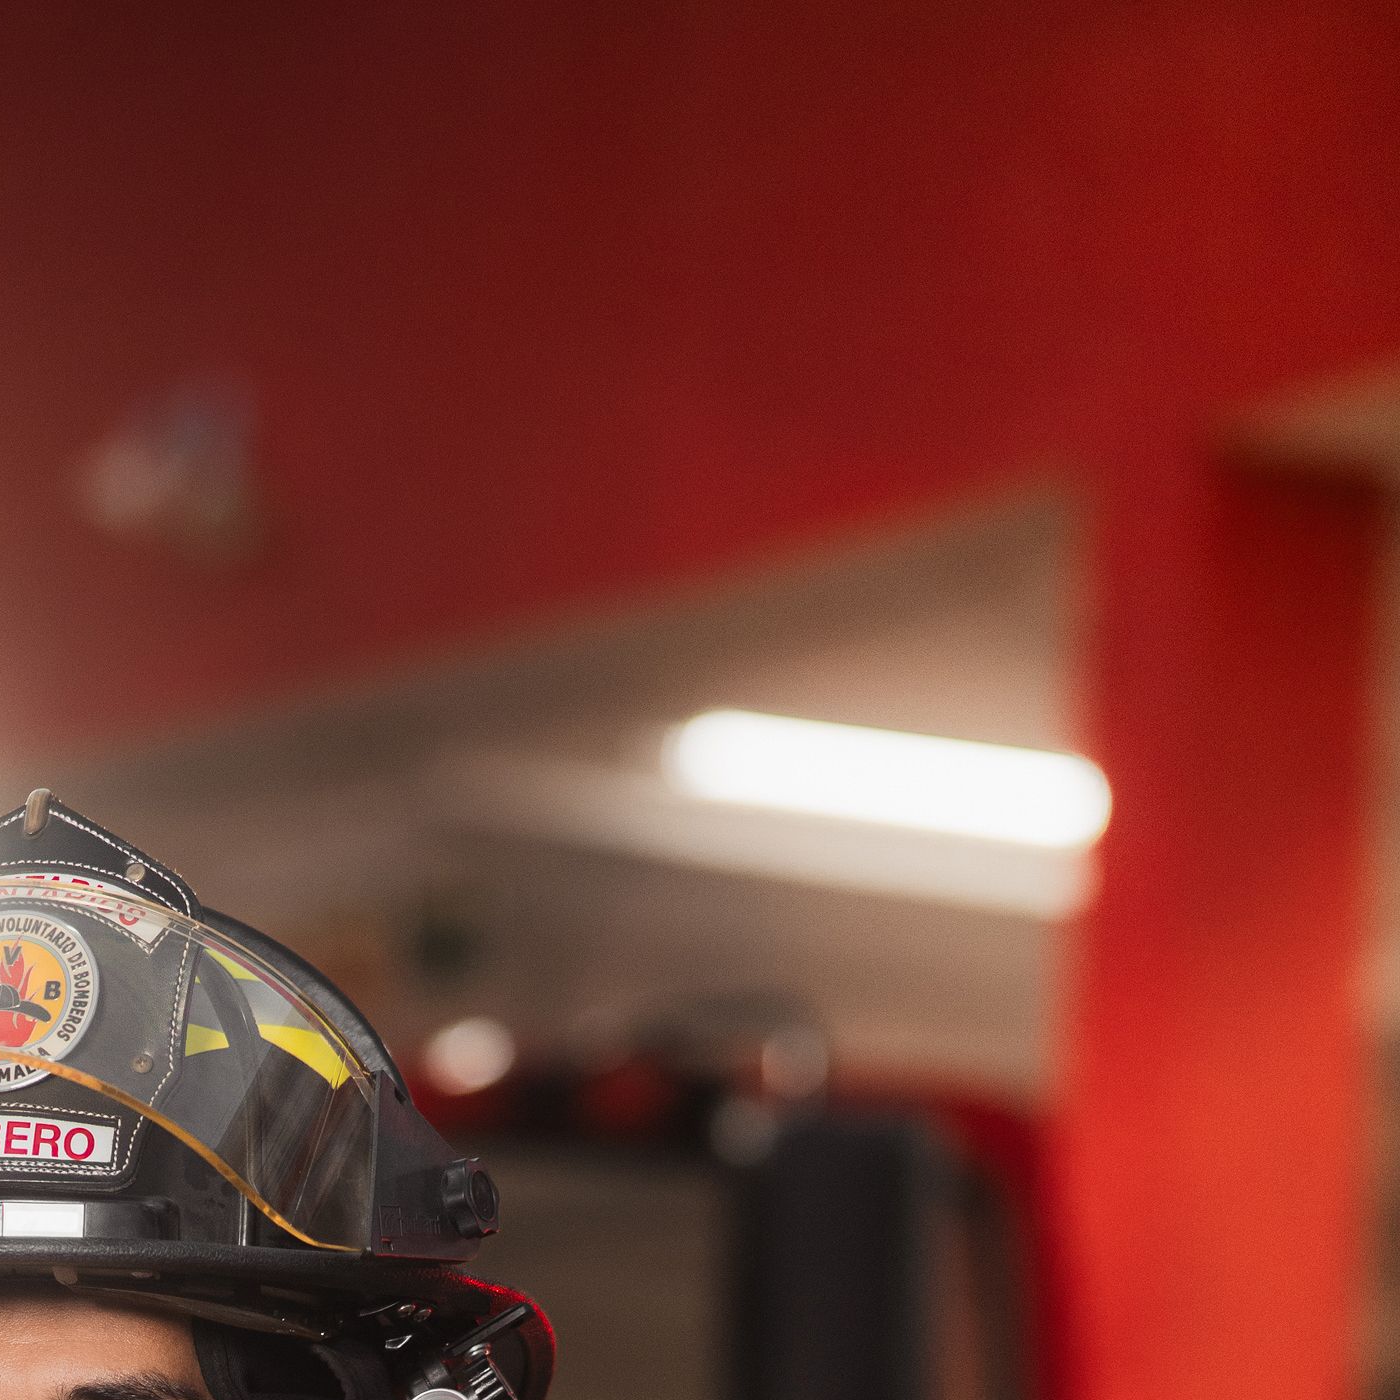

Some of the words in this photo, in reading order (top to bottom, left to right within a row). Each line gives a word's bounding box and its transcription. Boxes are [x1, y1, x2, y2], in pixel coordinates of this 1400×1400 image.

[3, 945, 22, 966] V
[69, 952, 87, 971] DE
[43, 980, 62, 1001] B
[57, 970, 90, 1042] BOMBEROS
